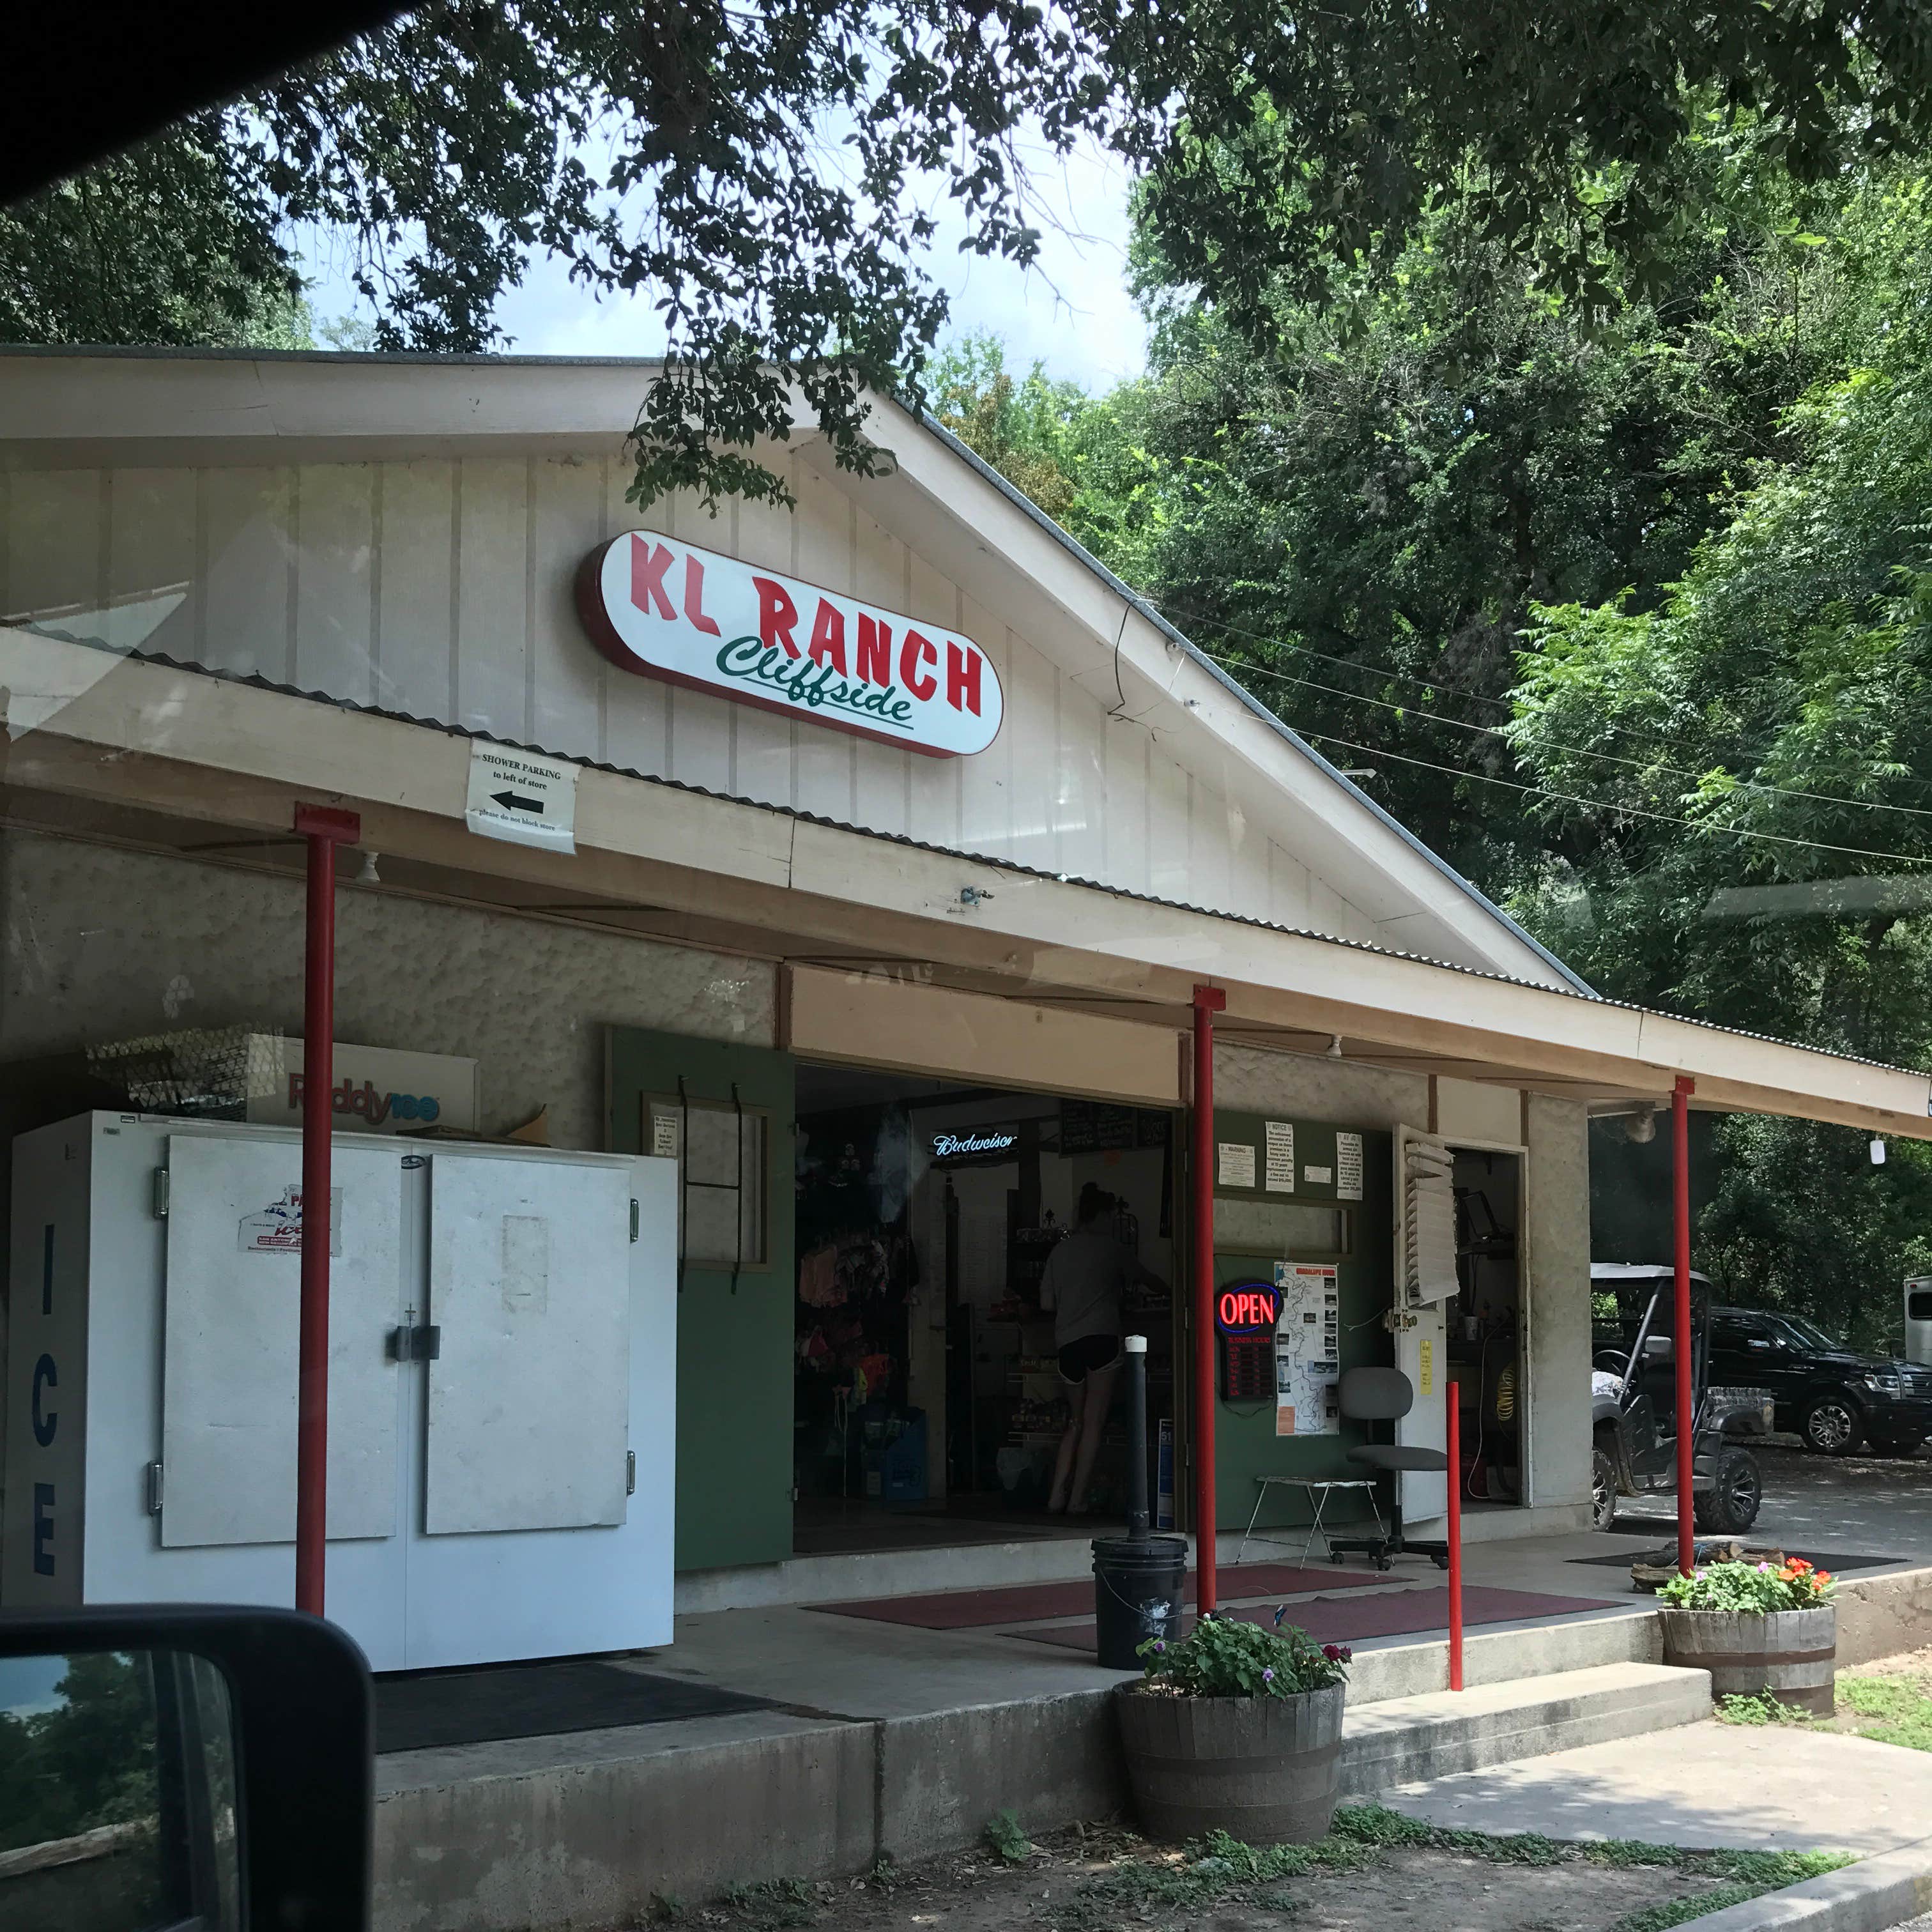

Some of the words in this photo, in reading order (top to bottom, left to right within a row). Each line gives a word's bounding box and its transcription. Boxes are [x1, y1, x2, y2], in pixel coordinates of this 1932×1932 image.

[631, 533, 721, 637] KL
[752, 576, 983, 717] RANCH
[716, 636, 912, 721] Cliffside
[482, 753, 520, 770] SHOWER
[523, 764, 561, 779] PARKING
[503, 772, 516, 783] left
[518, 777, 527, 785] of
[528, 781, 548, 790] store
[479, 809, 499, 818] please
[521, 818, 539, 828] block
[540, 822, 556, 831] store
[933, 1133, 1018, 1156] Budweiser
[1220, 1292, 1274, 1325] OPEN
[31, 1223, 58, 1577] ICE
